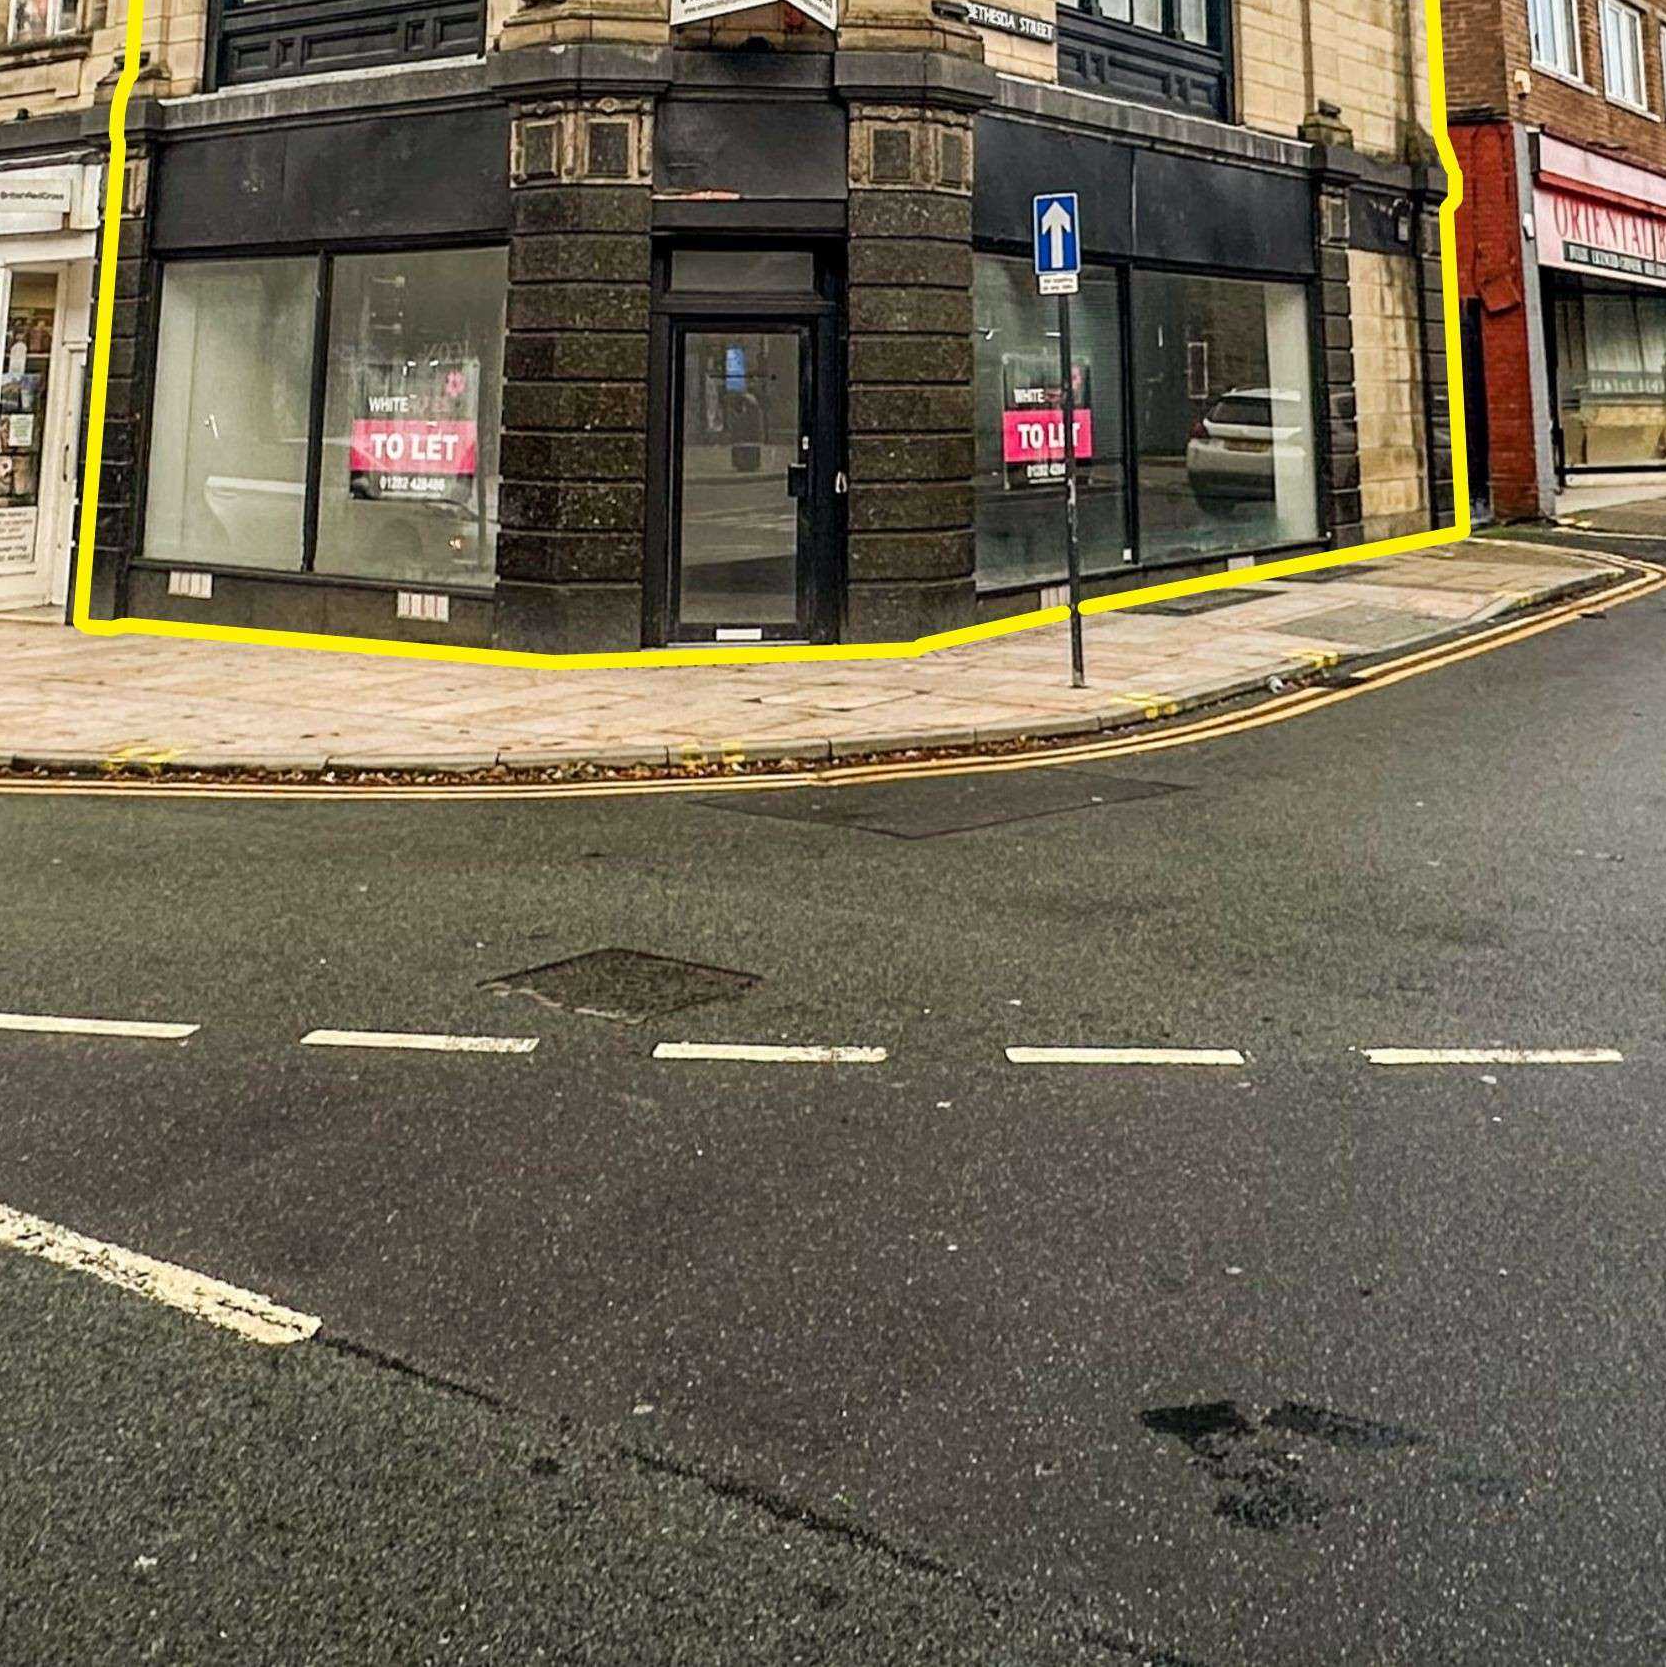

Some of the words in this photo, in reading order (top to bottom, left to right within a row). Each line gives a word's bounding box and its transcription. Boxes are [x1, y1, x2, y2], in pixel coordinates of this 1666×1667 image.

[1019, 16, 1054, 41] STREET
[369, 432, 405, 462] TO
[411, 432, 460, 462] LET
[1017, 423, 1045, 450] TO
